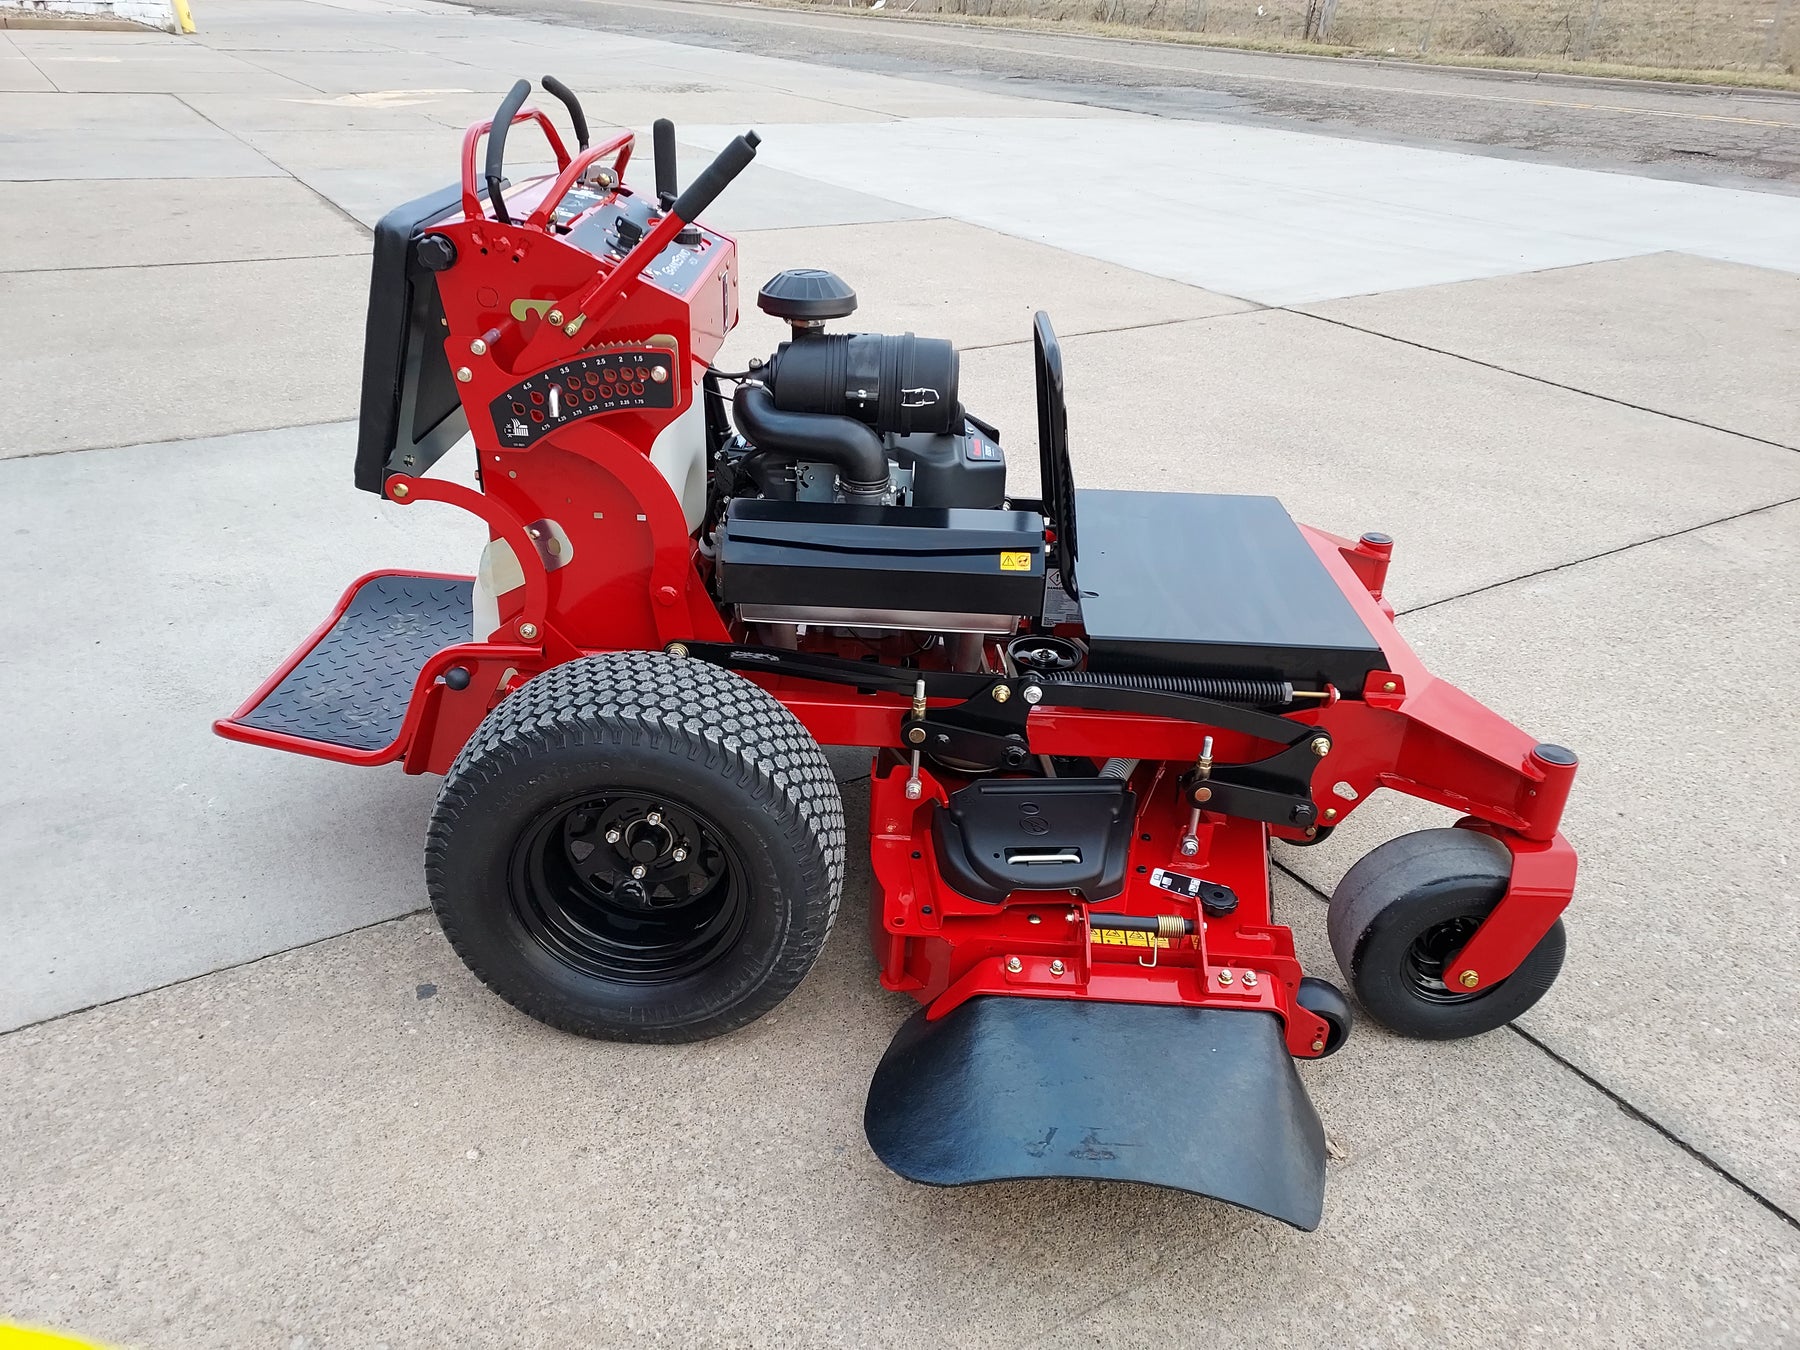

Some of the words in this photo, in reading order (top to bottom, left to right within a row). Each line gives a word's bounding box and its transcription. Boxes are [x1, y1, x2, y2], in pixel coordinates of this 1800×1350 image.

[522, 381, 533, 390] 4.5
[559, 366, 570, 375] 3.5
[581, 361, 587, 369] 3
[595, 357, 606, 366] 2.5
[618, 355, 624, 363] 2
